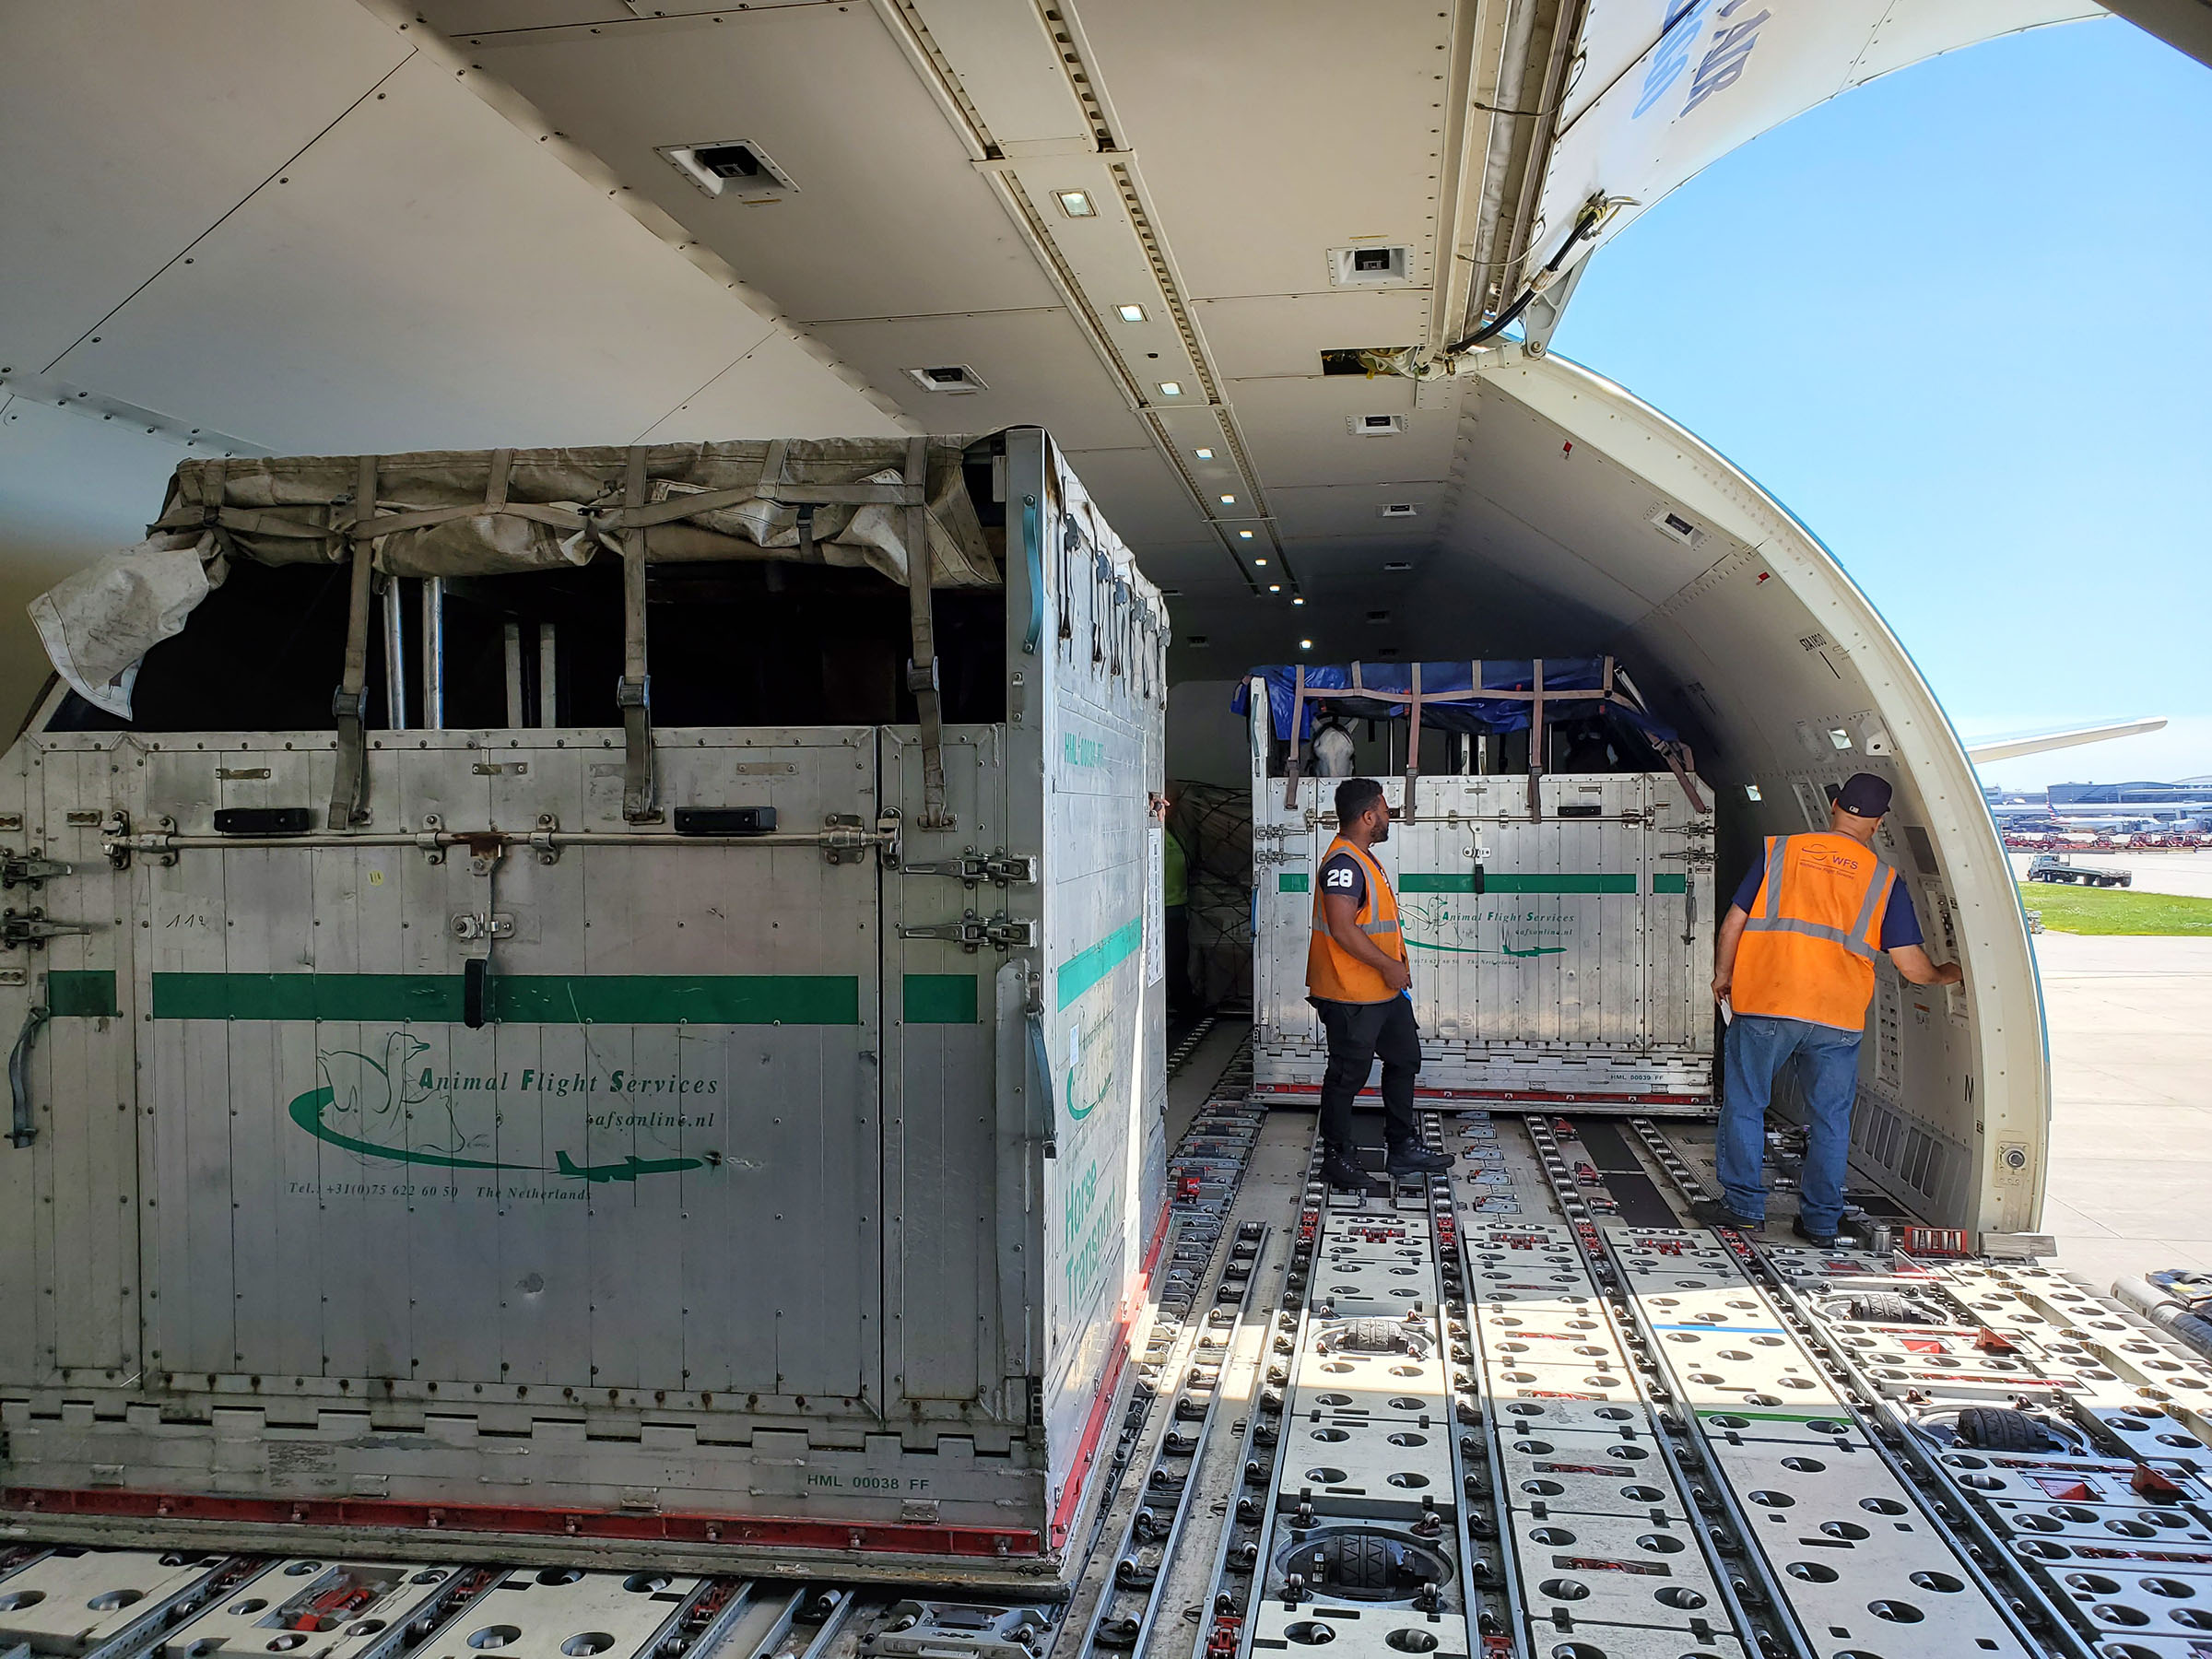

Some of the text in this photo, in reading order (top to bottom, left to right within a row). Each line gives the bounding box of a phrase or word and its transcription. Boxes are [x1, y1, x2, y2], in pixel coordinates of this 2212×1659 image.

[1679, 9, 1771, 118] AIR
[1832, 854, 1859, 870] WFS
[1326, 868, 1353, 888] 28
[1441, 911, 1575, 924] Animal Flight Services
[419, 1067, 718, 1098] Animal Flight Services
[421, 1185, 437, 1197] 60
[442, 1185, 458, 1198] 50
[477, 1186, 501, 1199] The
[1065, 1159, 1097, 1253] Horse
[806, 1474, 930, 1491] HML 00038 FF
